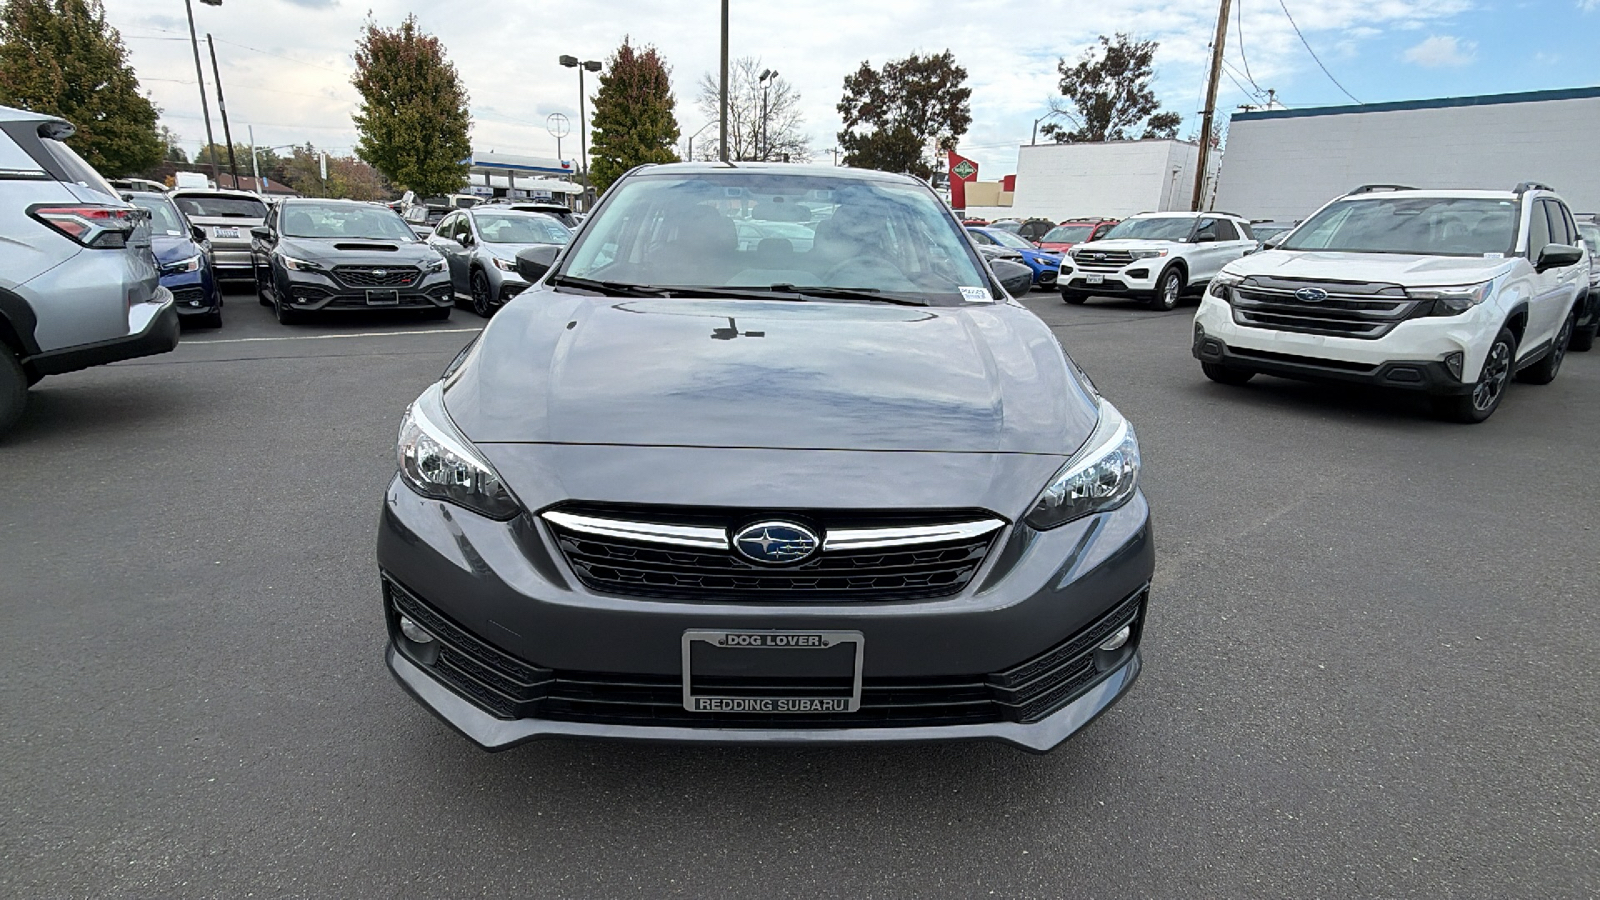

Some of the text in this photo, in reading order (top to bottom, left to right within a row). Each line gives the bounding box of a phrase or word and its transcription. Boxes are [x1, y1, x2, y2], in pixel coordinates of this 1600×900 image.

[727, 634, 819, 646] DOG LOVER
[700, 699, 845, 712] REDDING SUBARU
